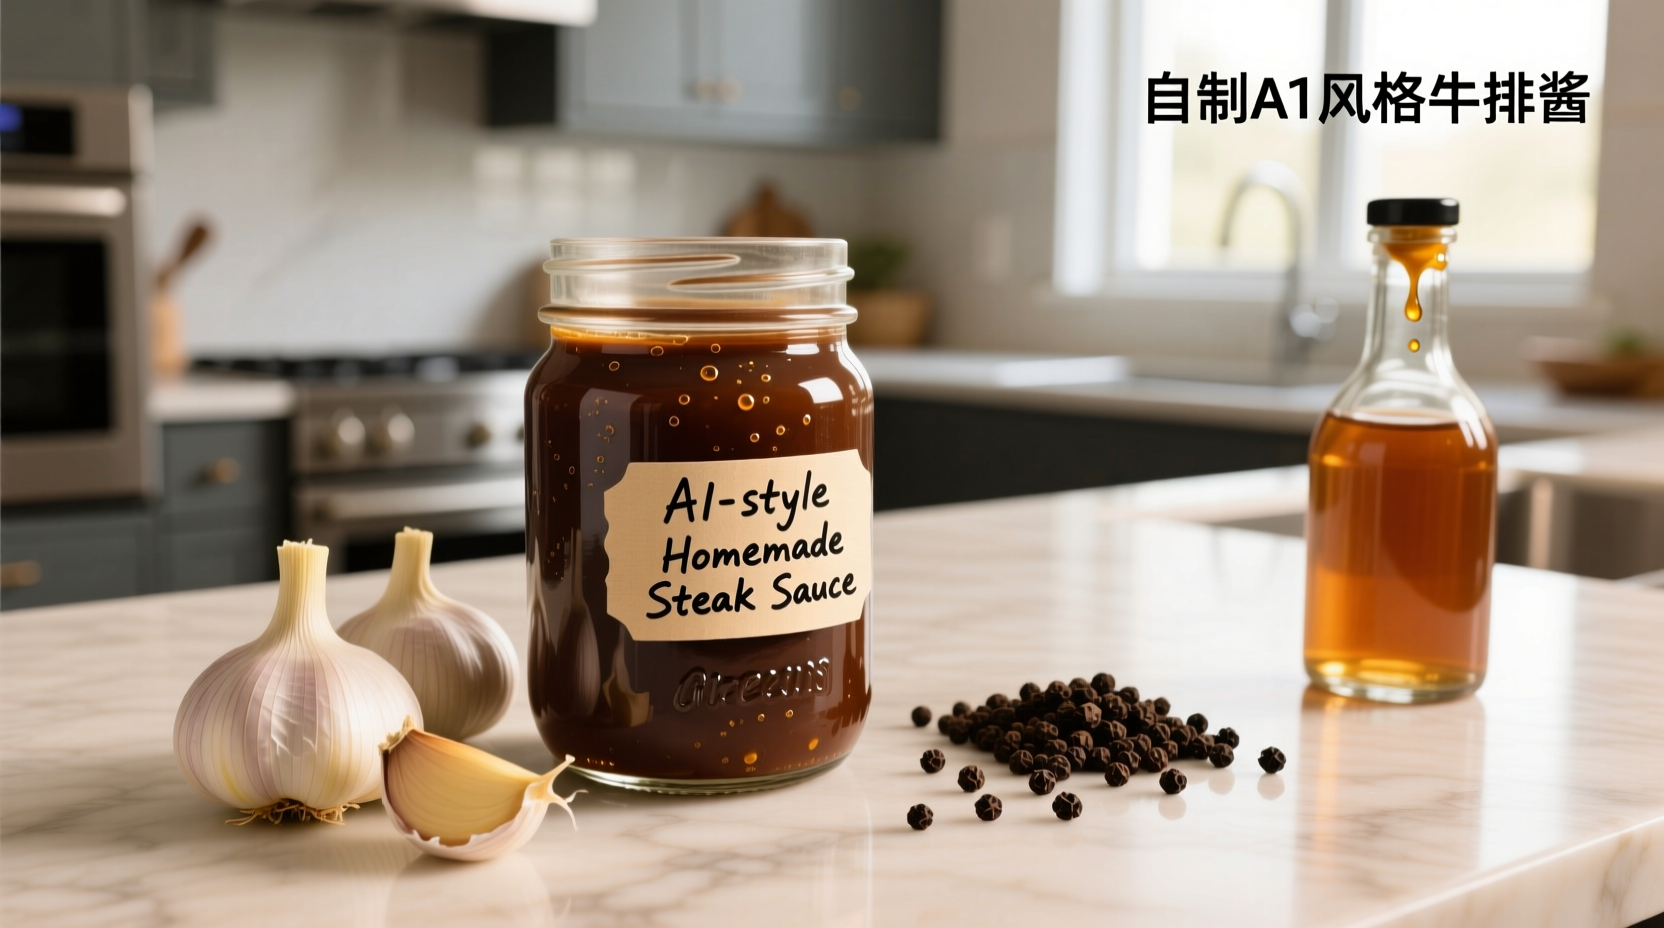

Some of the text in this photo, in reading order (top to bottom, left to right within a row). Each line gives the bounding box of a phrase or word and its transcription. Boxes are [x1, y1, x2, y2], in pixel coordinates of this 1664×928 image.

[661, 520, 845, 575] Homemade
[645, 572, 858, 620] Steak Sauce
